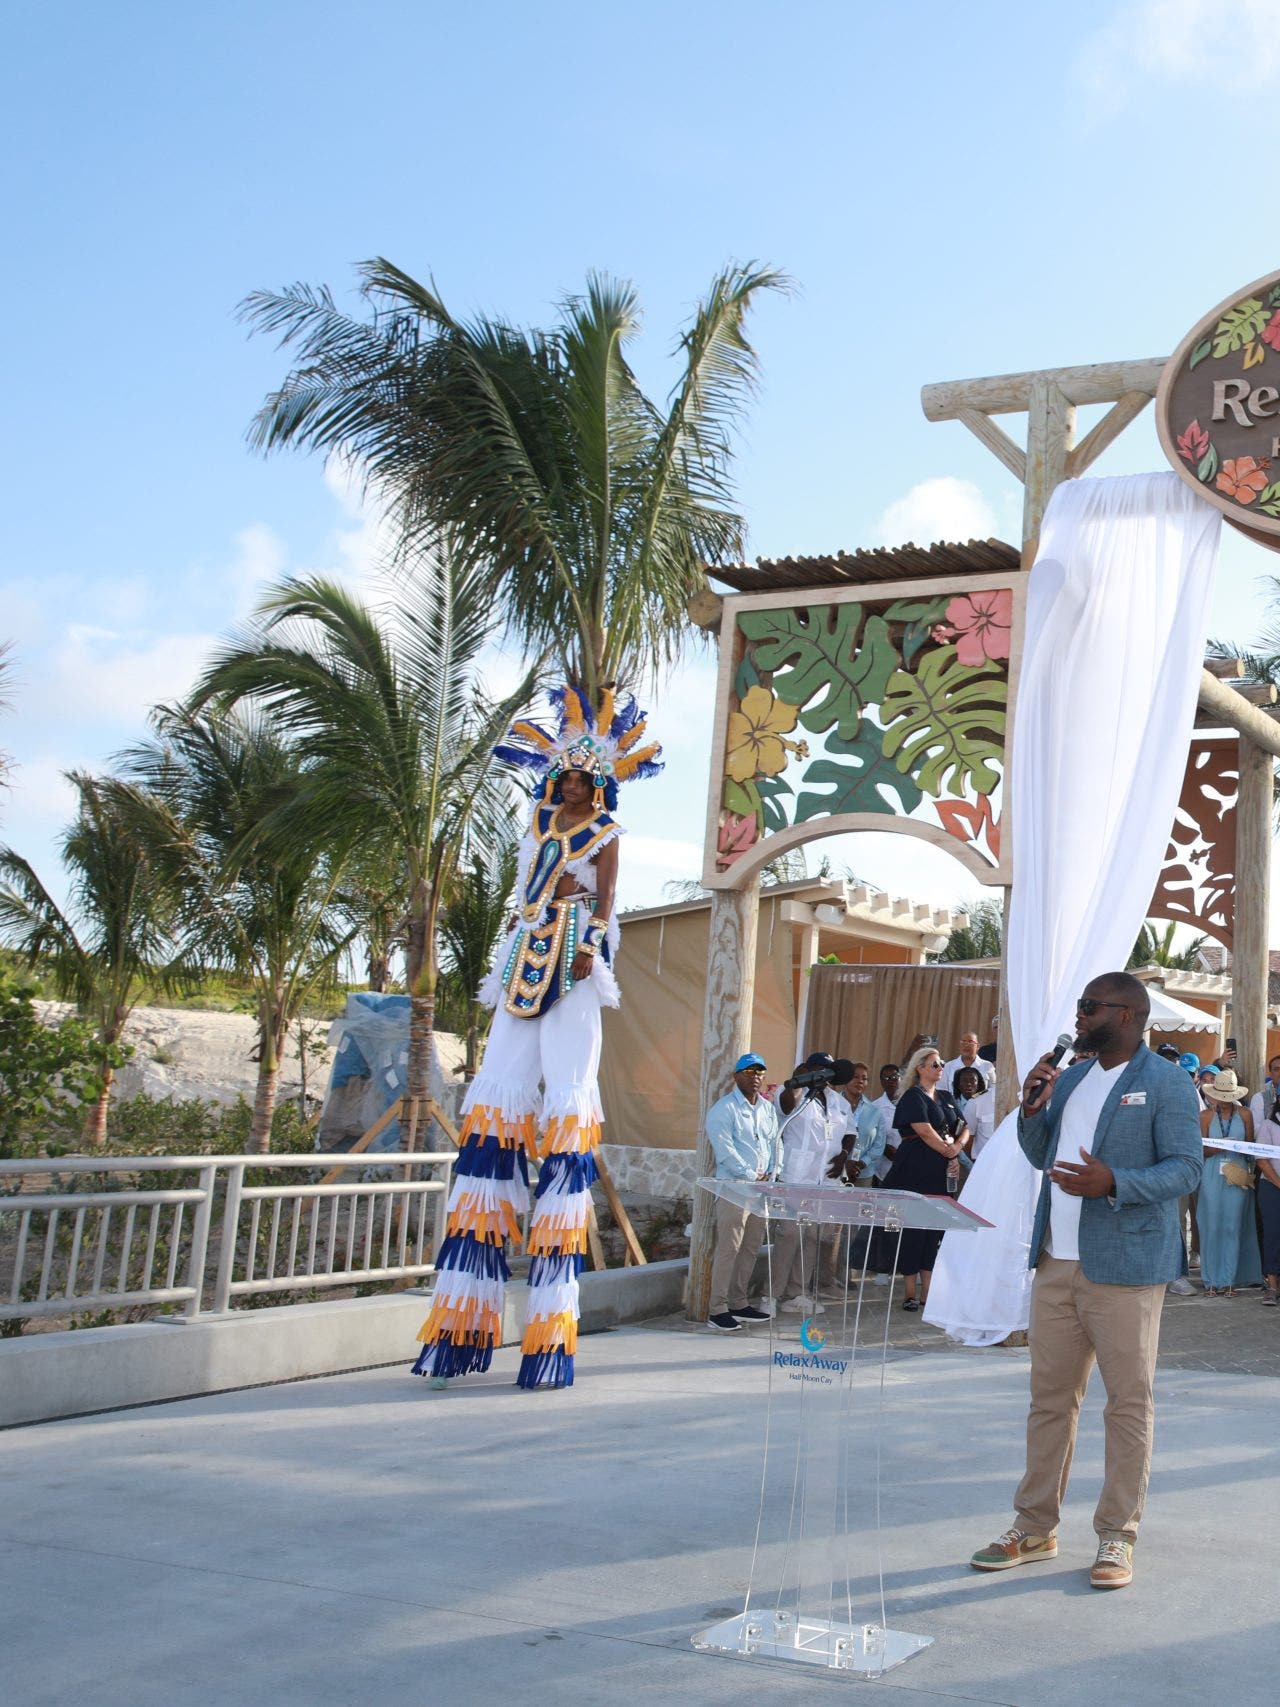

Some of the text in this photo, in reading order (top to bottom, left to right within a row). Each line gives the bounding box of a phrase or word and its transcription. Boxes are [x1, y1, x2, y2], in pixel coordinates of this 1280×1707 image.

[790, 1373, 832, 1385] Half Moon Cay
